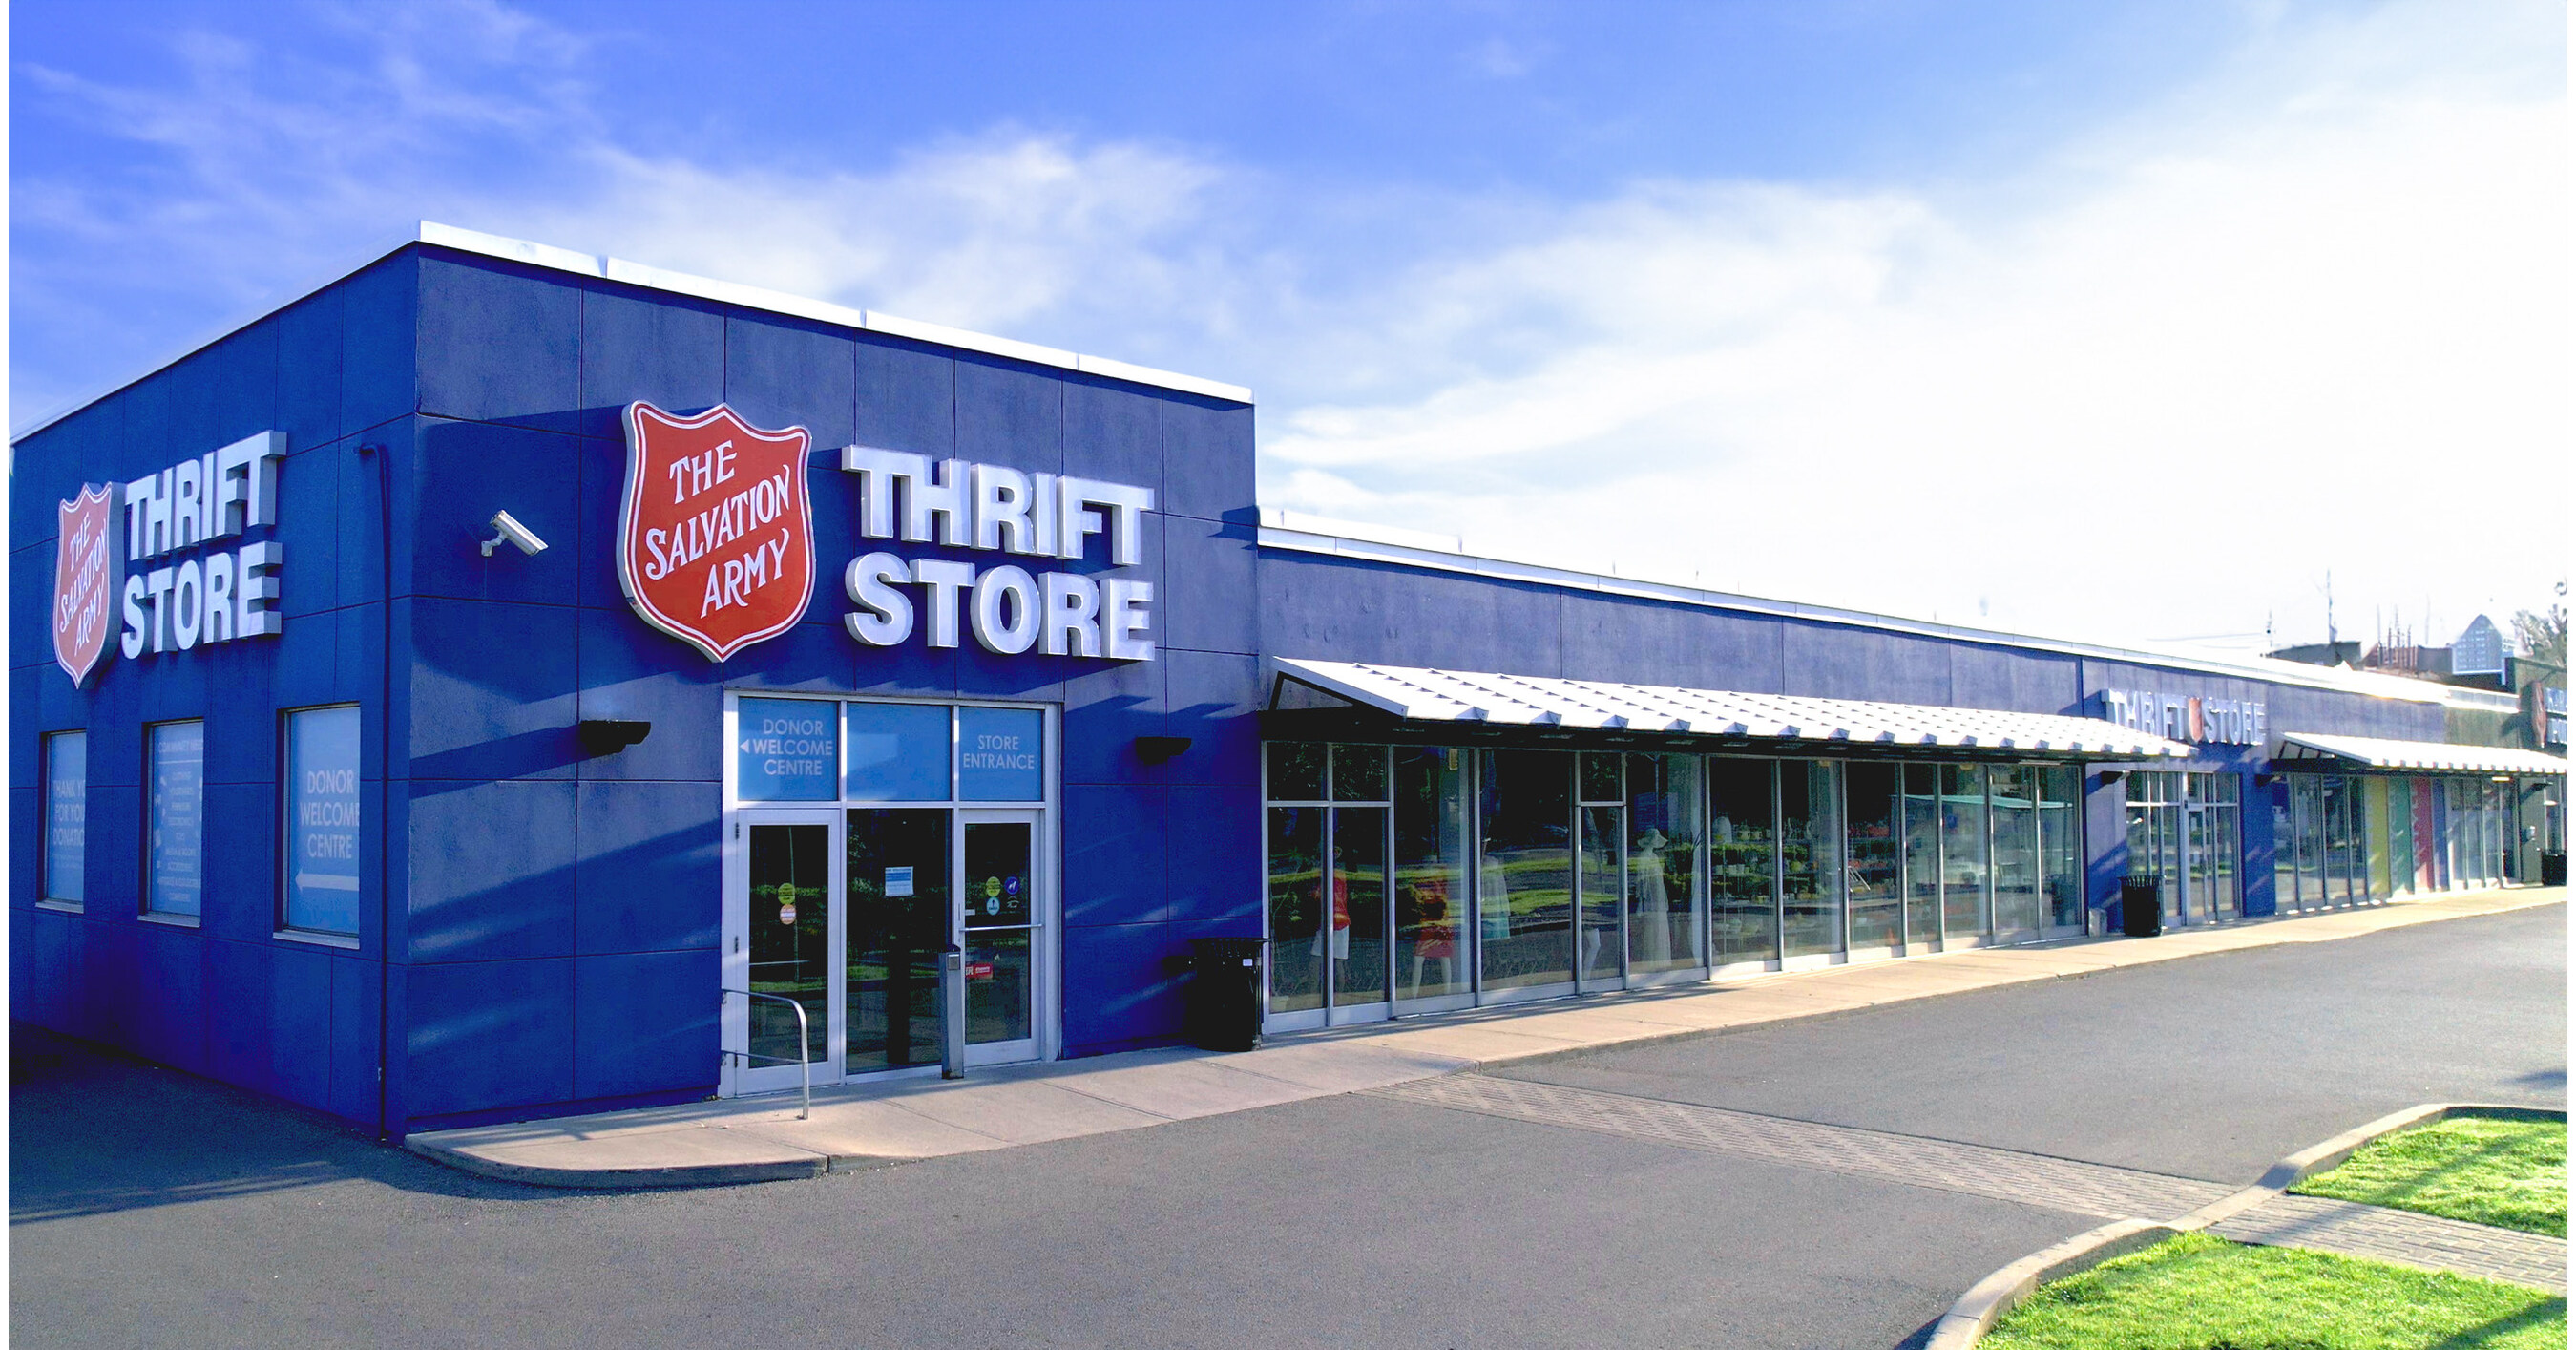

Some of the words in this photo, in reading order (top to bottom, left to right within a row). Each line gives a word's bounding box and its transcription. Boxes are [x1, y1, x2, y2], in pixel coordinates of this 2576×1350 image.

[125, 430, 286, 561] THRIFT
[668, 439, 738, 505] THE
[644, 463, 791, 580] SALVATION
[842, 444, 1155, 565] THRIFT
[69, 511, 92, 572] THE
[59, 517, 107, 633] SALVATION
[121, 541, 283, 660] STORE
[700, 527, 790, 619] ARMY
[73, 572, 105, 657] ARMY
[844, 551, 1155, 661] STORE
[764, 719, 824, 735] DONOR
[977, 734, 1019, 751] STORE
[2101, 687, 2188, 741] THRIFT
[2203, 696, 2266, 745] STORE
[752, 739, 833, 756] WELCOME
[764, 759, 822, 775] CENTRE
[962, 752, 1035, 770] ENTRANCE
[306, 769, 355, 794] DONOR
[52, 828, 86, 846] DONATIO
[307, 833, 353, 859] CENTRE
